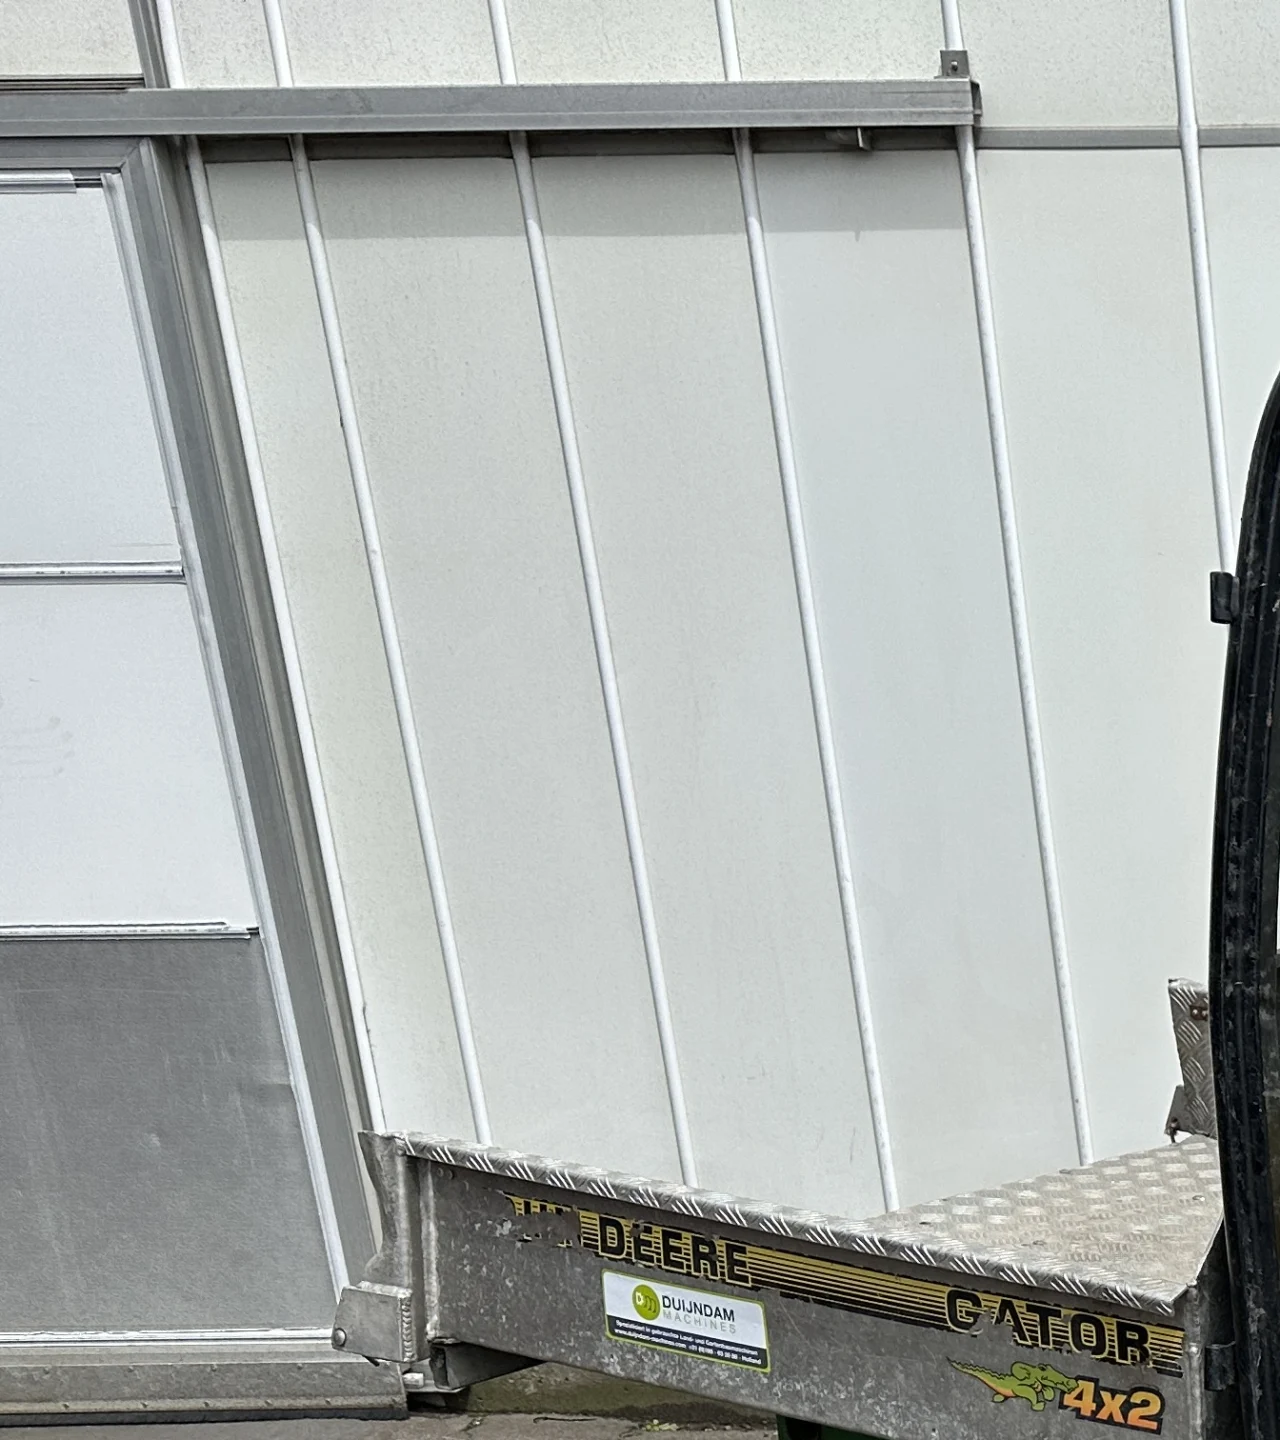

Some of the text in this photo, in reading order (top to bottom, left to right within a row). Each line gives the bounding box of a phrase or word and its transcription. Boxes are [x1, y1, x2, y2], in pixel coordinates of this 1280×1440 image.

[598, 1215, 752, 1287] DEERE
[661, 1294, 736, 1322] DUIJNDAM
[663, 1309, 737, 1335] MACHINES
[945, 1287, 1152, 1367] GATOR
[1062, 1377, 1163, 1432] 4x2
